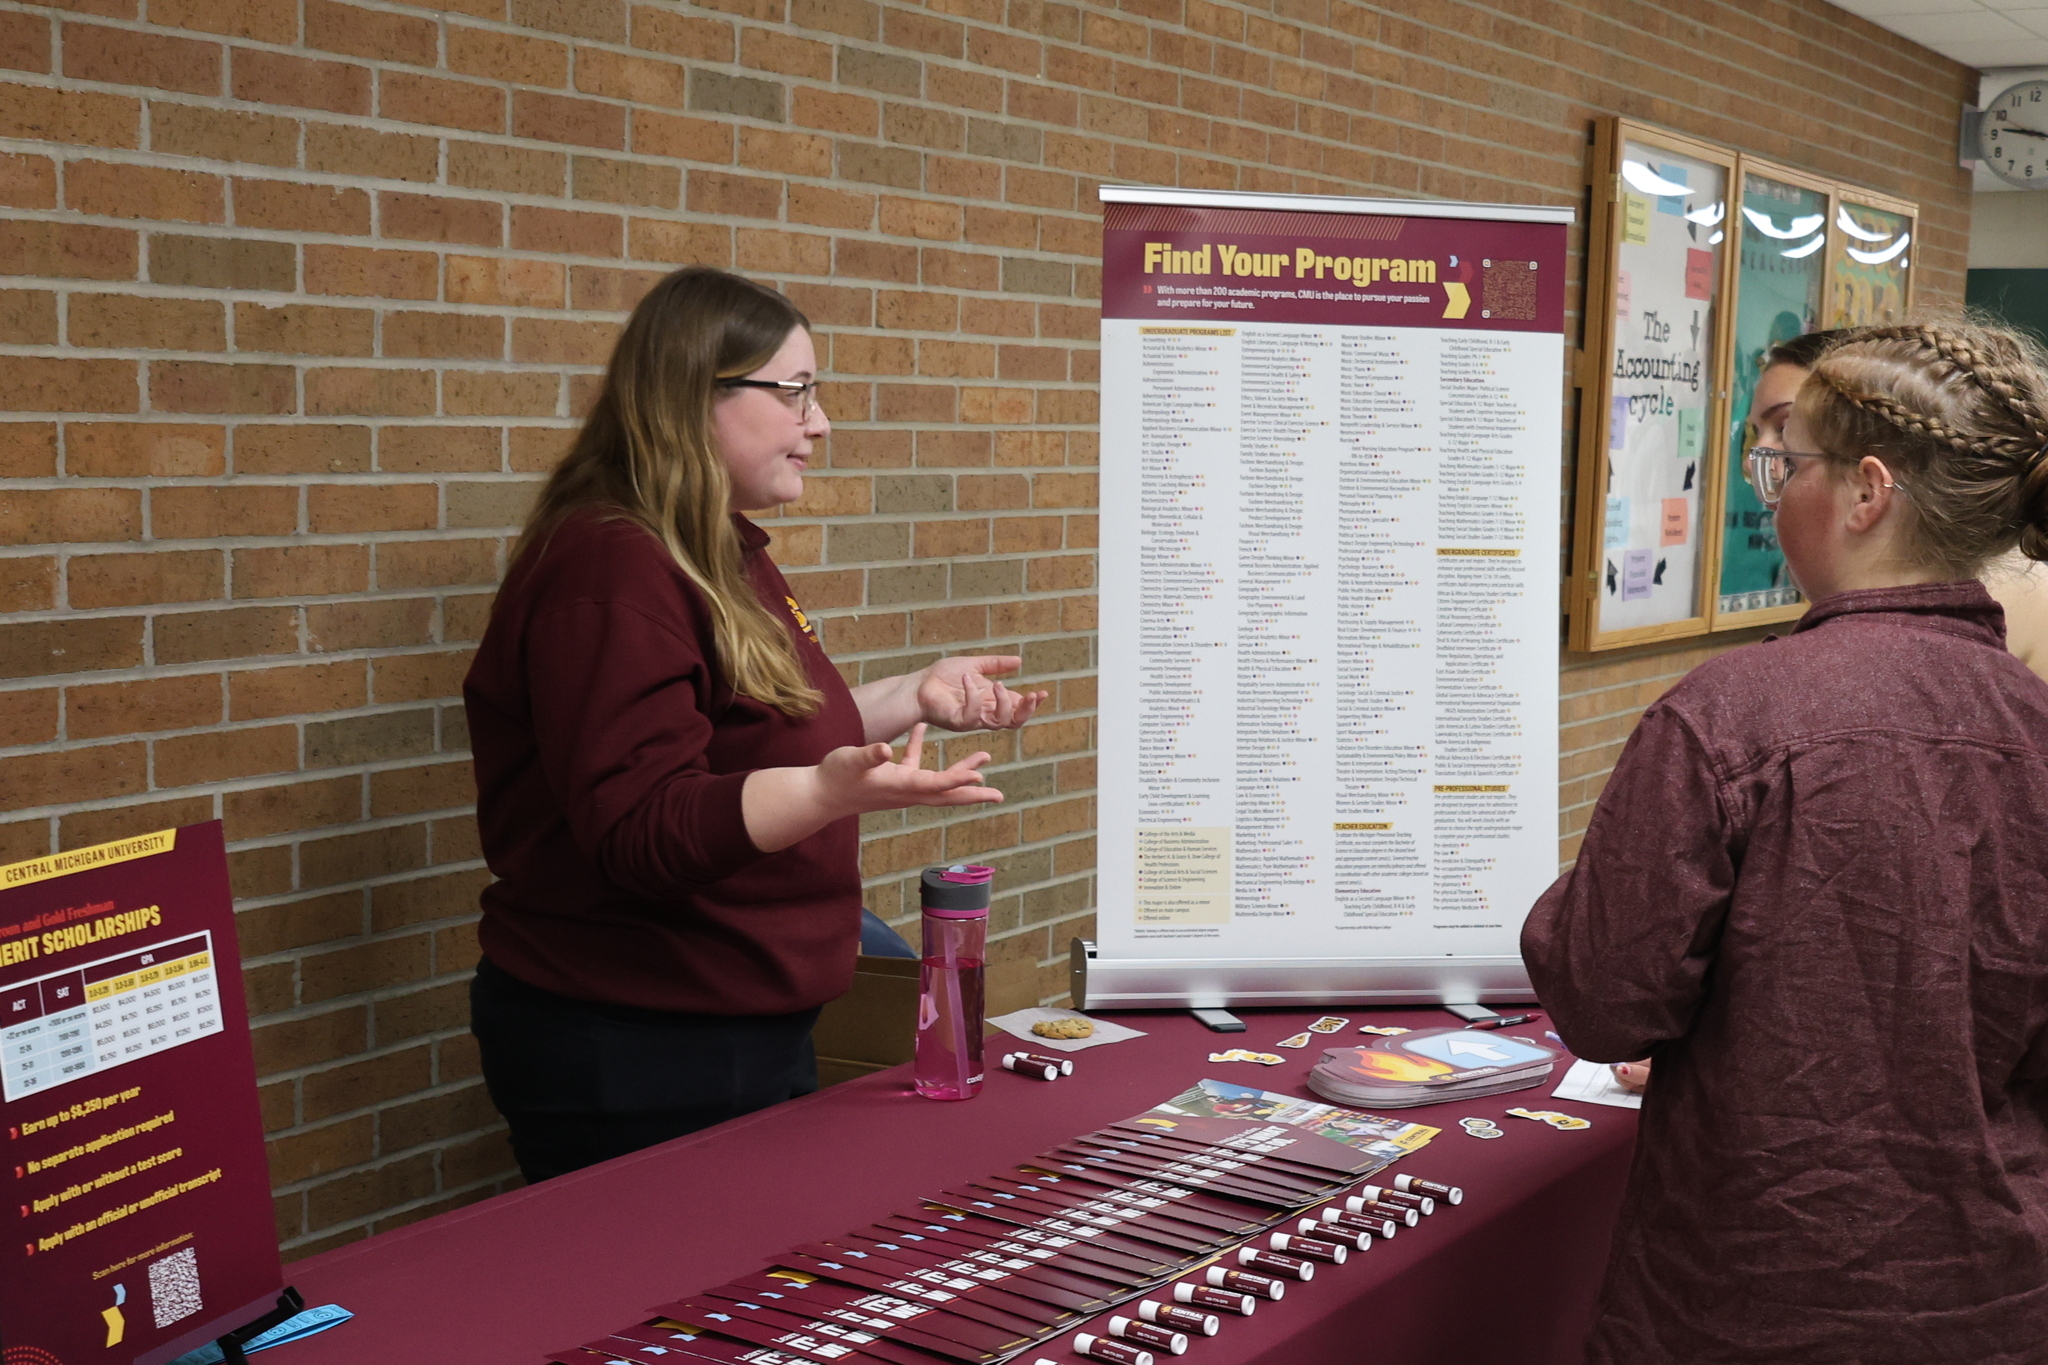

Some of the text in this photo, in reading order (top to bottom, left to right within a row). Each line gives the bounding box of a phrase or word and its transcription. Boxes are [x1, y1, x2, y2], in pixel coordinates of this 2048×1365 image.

[2012, 96, 2022, 107] 11
[2030, 90, 2041, 102] 12
[1996, 110, 2007, 121] 10
[1990, 129, 1998, 140] 9
[1994, 146, 2002, 158] 8
[2008, 160, 2014, 172] 7
[2024, 164, 2033, 177] 6
[1144, 242, 1436, 288] Find Your Program
[1157, 285, 1430, 304] With more than 200 academic programs, CMU is the place to pursue your passion
[1157, 298, 1255, 310] and prepare for your future.
[1644, 310, 1670, 343] The
[1613, 349, 1700, 392] Accounting
[1629, 385, 1674, 423] cycle
[6, 835, 165, 882] CENTRAL MICHIGAN UNIVERSITY
[23, 915, 42, 932] and
[42, 910, 66, 926] Gold
[67, 900, 115, 921] Freshman
[42, 905, 161, 955] SCHOLARSHIPS
[140, 953, 155, 966] GPA
[12, 986, 70, 1012] ACT SAT
[22, 1086, 141, 1136] Earn up to $8,250 per year
[27, 1110, 174, 1175] No separate application required
[33, 1147, 183, 1213] Apply with or without a test score
[1422, 1180, 1449, 1191] CENTRAL
[39, 1167, 222, 1251] Apply with an official or unofficial transcript
[92, 1231, 195, 1281] Scan here for more information:
[1239, 1272, 1270, 1284] CENTRAL
[1172, 1307, 1204, 1320] CENTRAL
